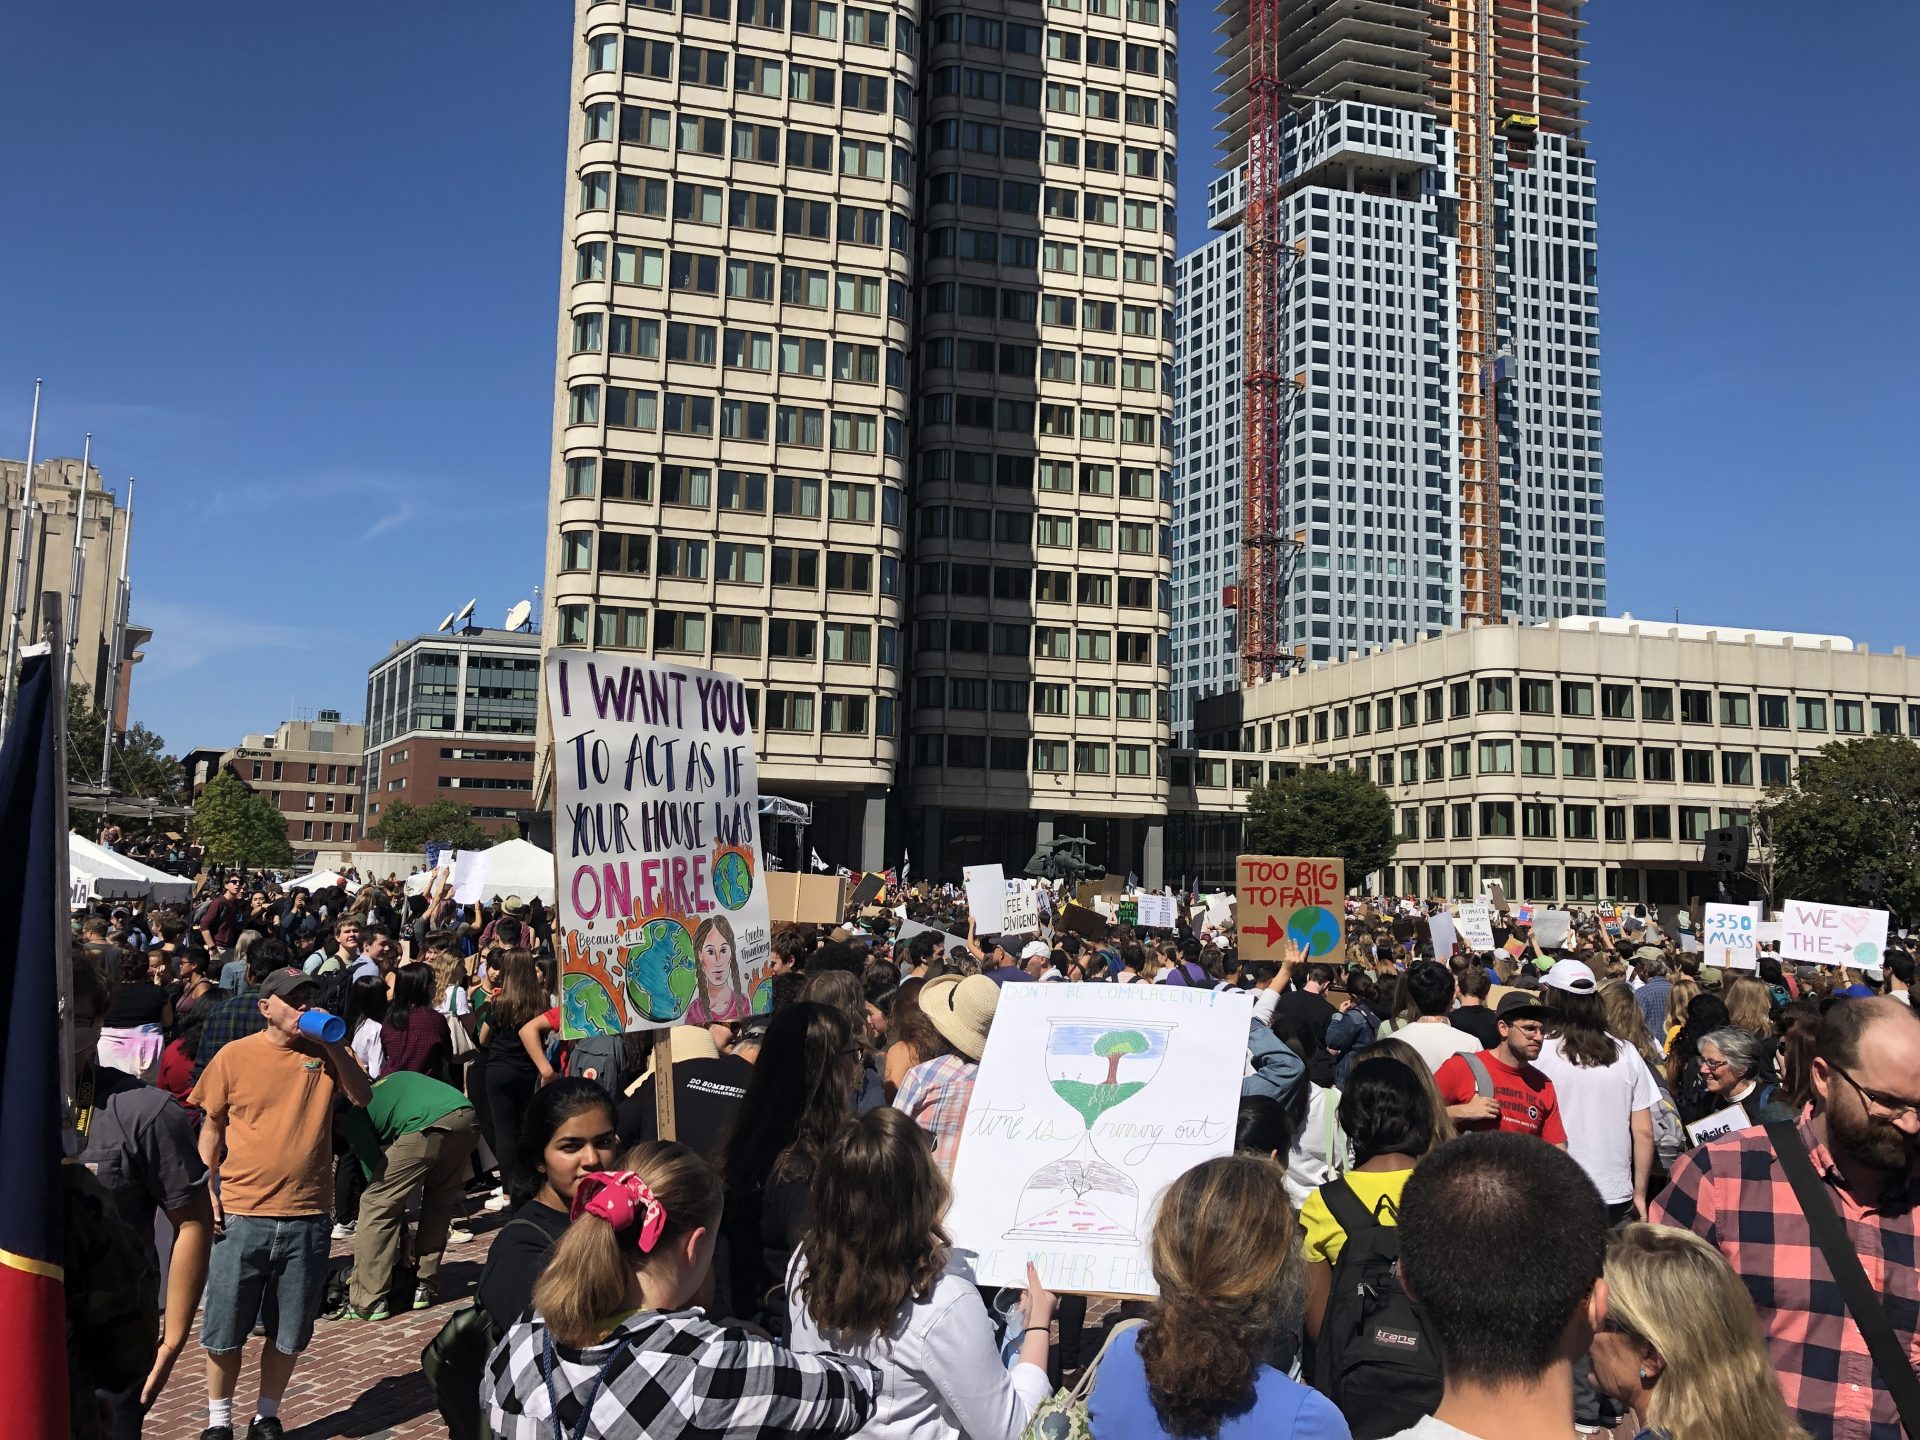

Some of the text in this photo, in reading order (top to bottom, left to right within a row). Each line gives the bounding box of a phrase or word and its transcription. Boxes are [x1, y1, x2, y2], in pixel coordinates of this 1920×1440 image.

[558, 659, 746, 736] I WANT YOU
[566, 730, 746, 798] TO ACT AS IF
[565, 800, 752, 858] YOUR HOUSE WAS
[571, 854, 715, 920] ON FIRE.
[1241, 861, 1338, 890] TOO BIG
[72, 884, 87, 904] IA
[1006, 898, 1022, 913] FEE
[1241, 886, 1333, 908] TO FAIL
[1716, 913, 1752, 931] 350
[1796, 906, 1838, 929] WE
[579, 932, 621, 948] Because
[1709, 931, 1753, 949] MASS
[1787, 932, 1834, 955] THE
[1066, 984, 1085, 999] BE
[702, 1081, 746, 1094] SOMETHIN
[76, 1108, 87, 1131] Nikon
[970, 1100, 1226, 1166] time is running out
[966, 1248, 1009, 1278] AVE
[1108, 1255, 1152, 1290] EAR
[1377, 1329, 1417, 1345] trans
